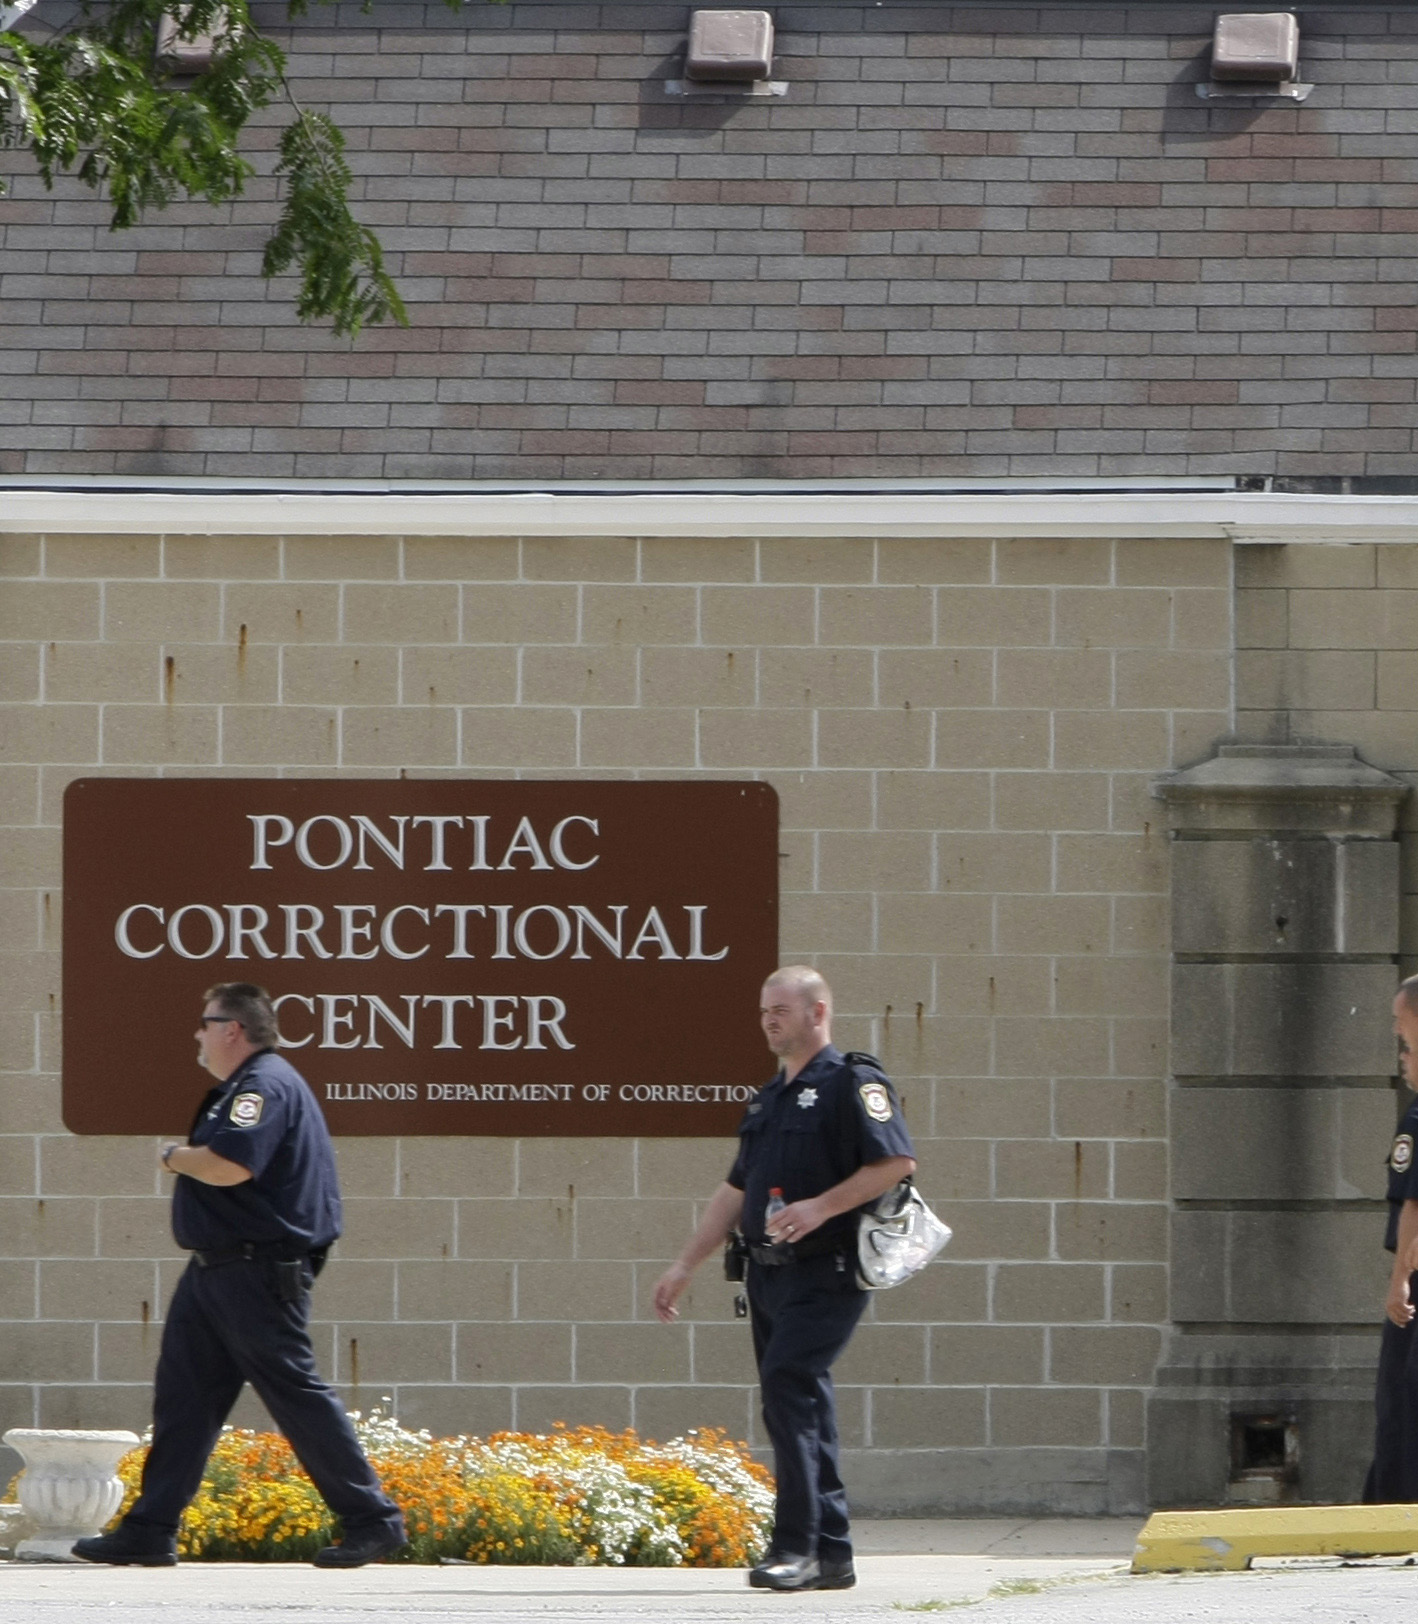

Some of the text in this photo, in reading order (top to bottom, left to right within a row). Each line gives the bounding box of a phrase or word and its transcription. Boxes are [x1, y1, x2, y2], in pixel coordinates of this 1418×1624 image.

[245, 814, 601, 871] PONTIAC
[113, 903, 730, 961] CORRECTIONAL
[271, 994, 576, 1050] CENTER
[325, 1083, 763, 1102] ILLINOIS DEPARTMENT OF CORRECTION
